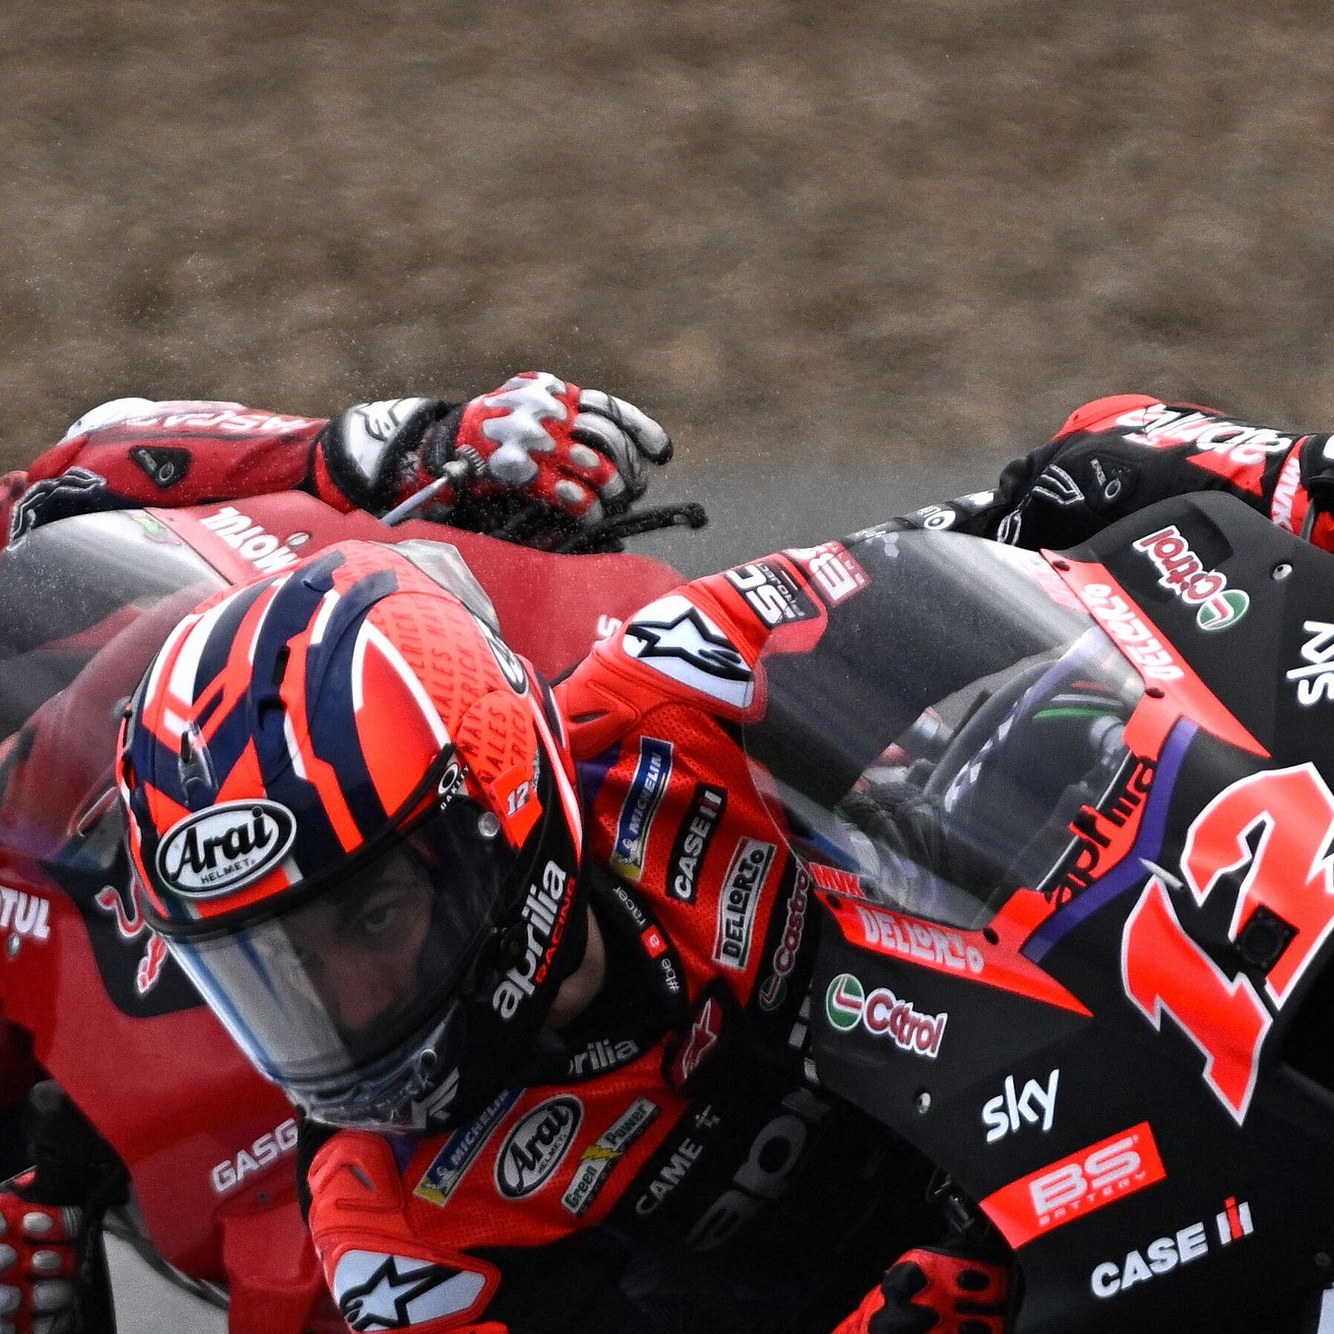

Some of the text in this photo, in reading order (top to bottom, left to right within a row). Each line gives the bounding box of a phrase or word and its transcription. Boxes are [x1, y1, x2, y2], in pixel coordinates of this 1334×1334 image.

[166, 806, 269, 883] Arai
[200, 857, 254, 886] HELMET
[674, 813, 710, 899] CASE
[493, 860, 566, 1019] aprilia
[612, 885, 647, 927] racer
[773, 862, 812, 976] Castro
[568, 1038, 641, 1076] rilia
[450, 1087, 511, 1169] MICHELIN
[982, 1069, 1062, 1144] sky
[211, 1117, 299, 1192] GASG
[508, 1102, 568, 1194] Arai
[565, 1165, 597, 1210] Green
[604, 1103, 648, 1146] Power
[635, 1136, 704, 1216] CAME
[1029, 1135, 1142, 1218] BS
[1090, 1227, 1209, 1299] CASE
